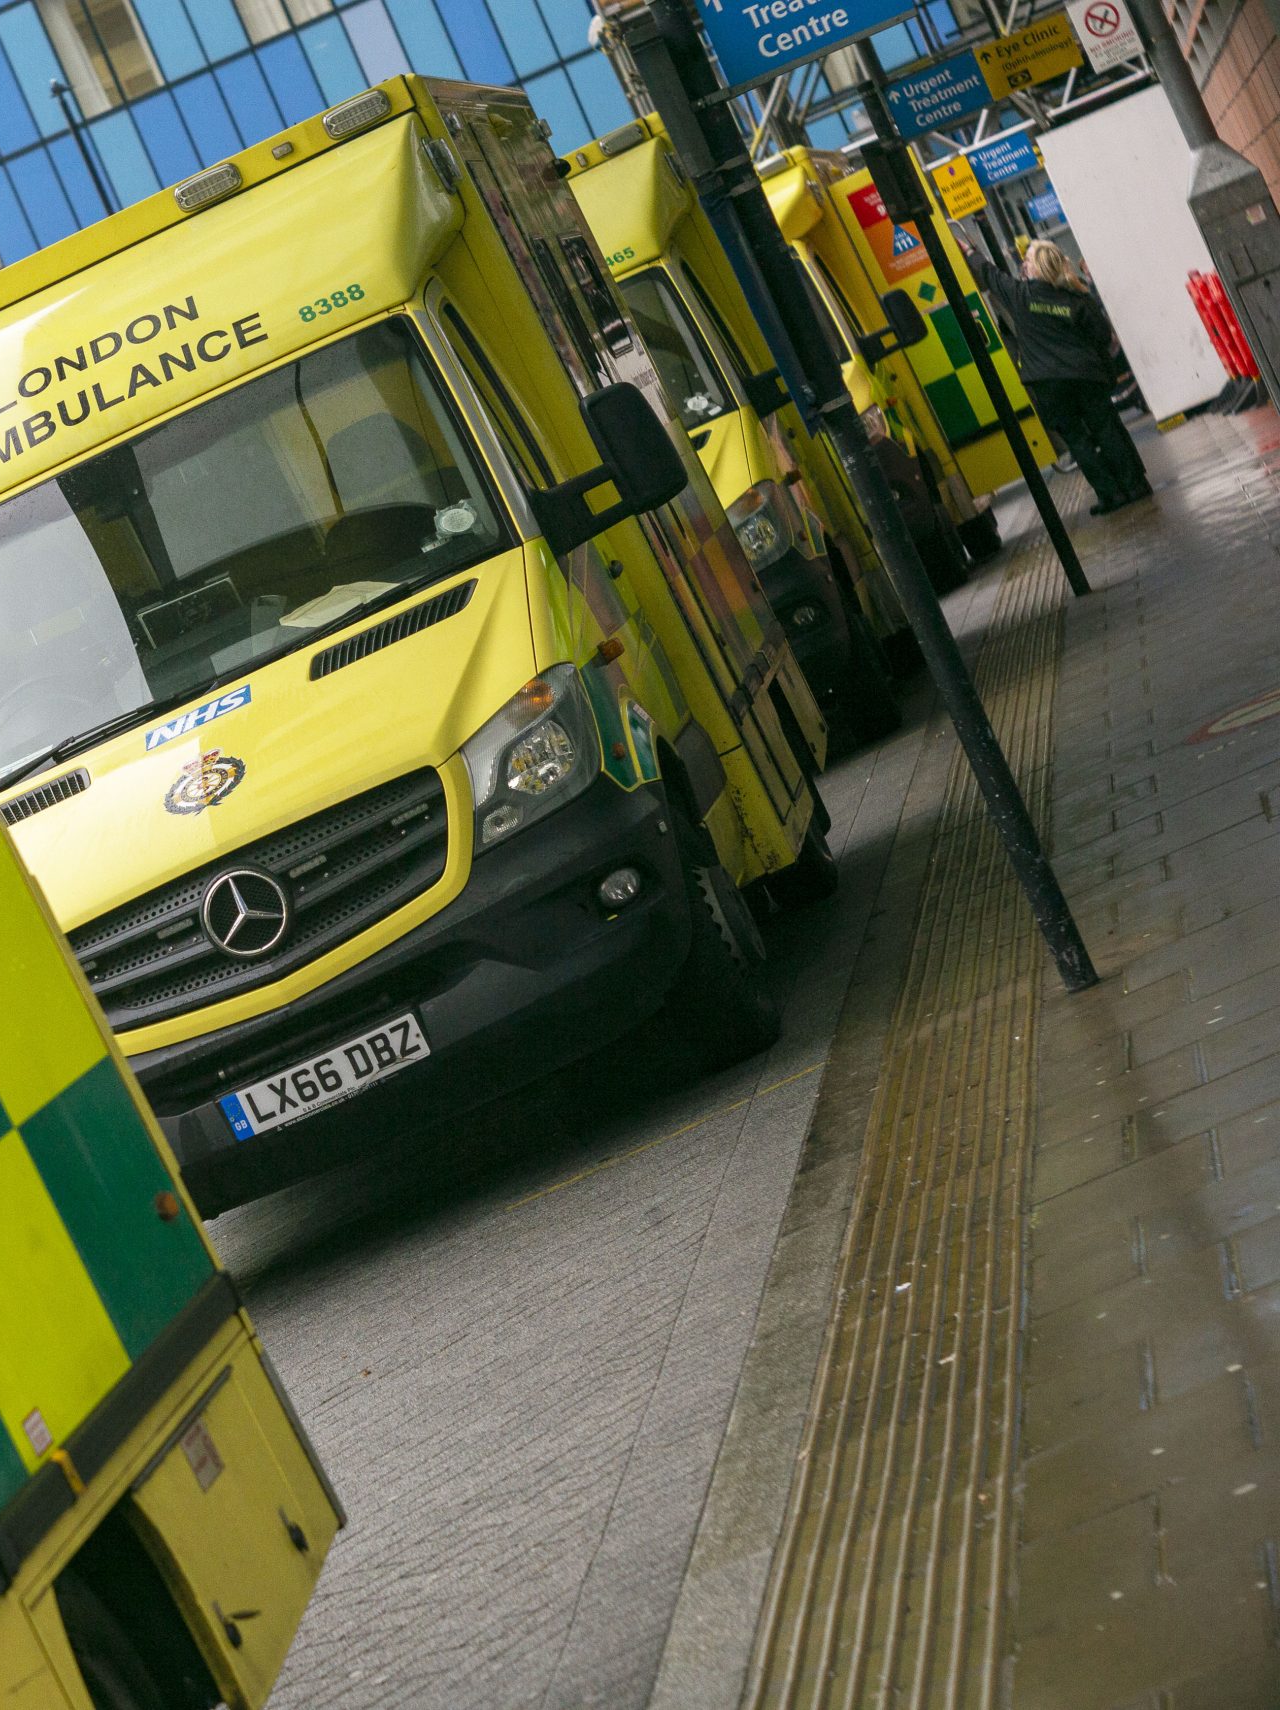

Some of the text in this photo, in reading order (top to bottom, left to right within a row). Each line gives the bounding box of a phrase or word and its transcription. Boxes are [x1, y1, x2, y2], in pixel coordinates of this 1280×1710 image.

[742, 0, 822, 28] Trea
[758, 9, 849, 57] Centre
[995, 24, 1060, 58] Eye Clinic
[903, 69, 953, 98] Urgent
[908, 74, 980, 112] Treatment
[916, 101, 962, 127] Centre
[979, 142, 1012, 160] Urgent
[983, 145, 1030, 170] Treatment
[987, 162, 1018, 180] Centre
[895, 236, 914, 252] 111
[298, 283, 366, 323] 8388
[147, 686, 247, 750] NHS
[245, 1020, 422, 1124] LX66 DBZ
[234, 1119, 248, 1131] GB
